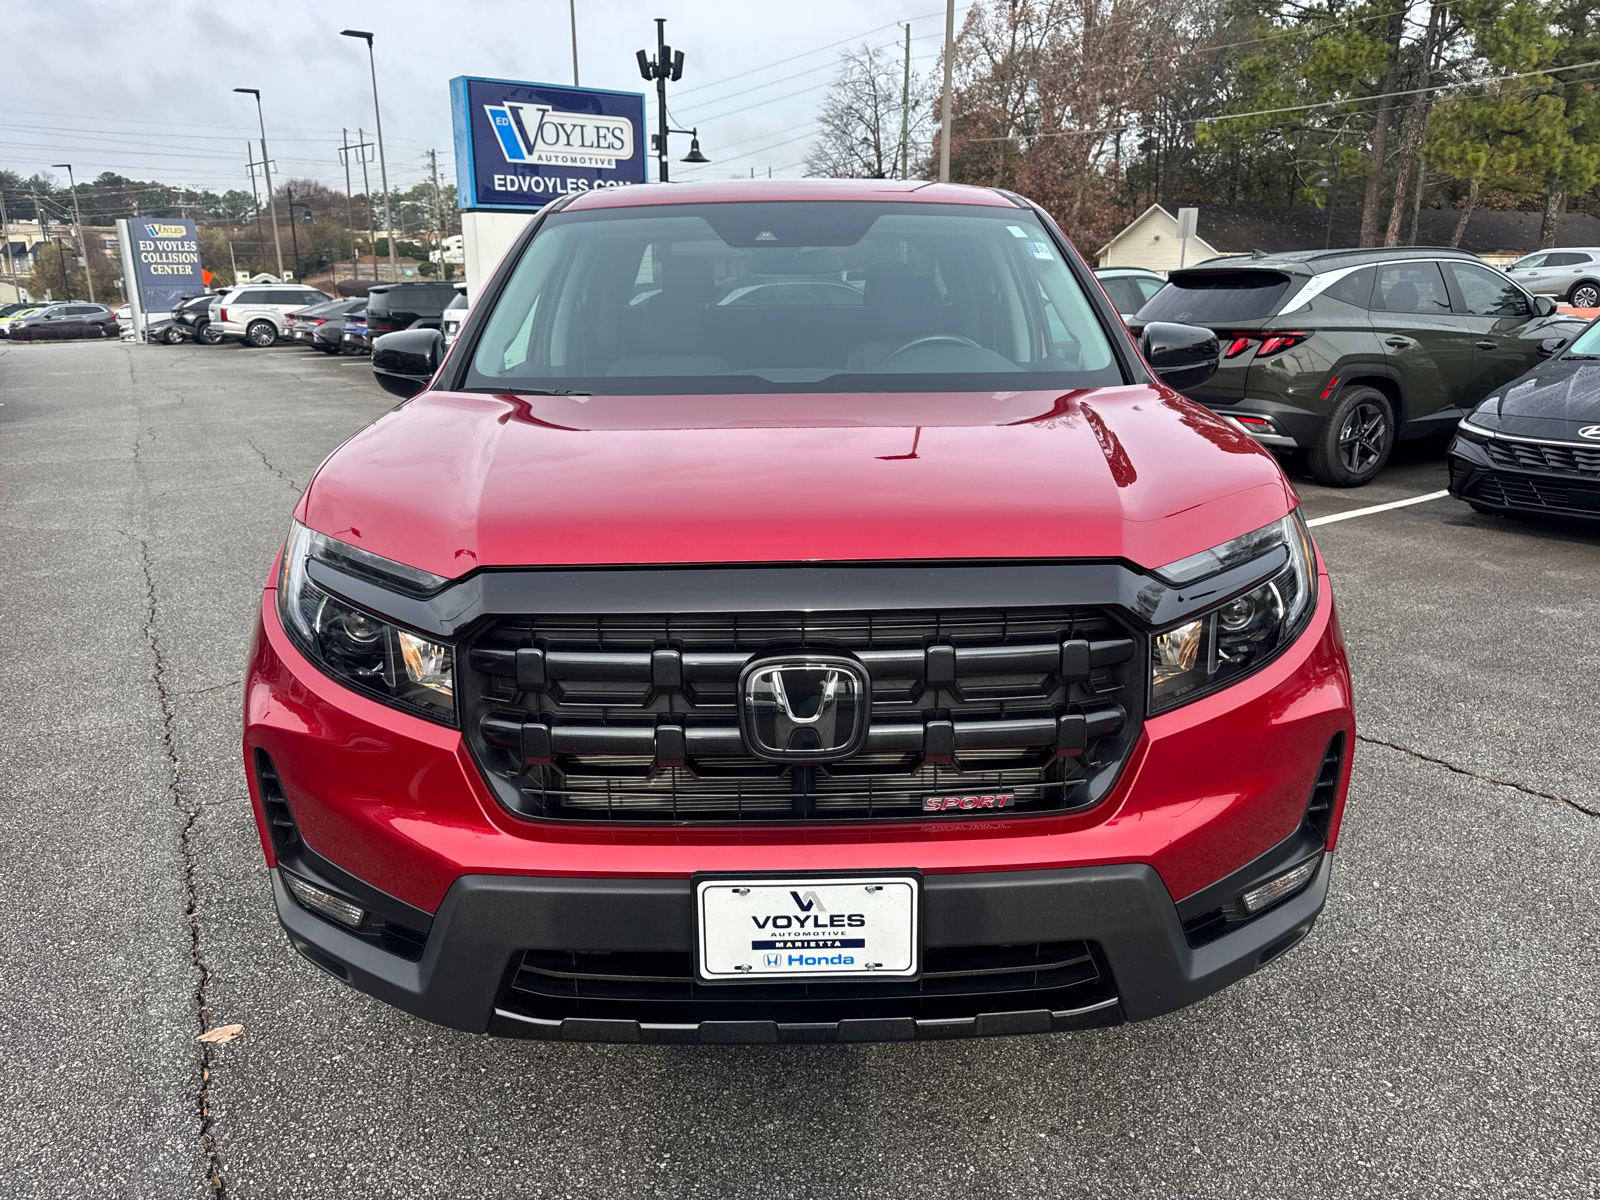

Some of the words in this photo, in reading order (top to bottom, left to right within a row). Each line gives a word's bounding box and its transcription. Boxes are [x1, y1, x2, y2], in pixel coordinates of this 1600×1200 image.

[496, 117, 509, 126] ED
[507, 105, 625, 156] VOYLES
[537, 154, 614, 167] AUTOMOTIVE
[493, 174, 632, 194] EDVOYLESC
[151, 224, 184, 236] VOYLES
[139, 241, 154, 251] ED
[156, 241, 197, 251] VOYLES
[141, 252, 198, 263] COLLISION
[150, 264, 193, 275] CENTER
[923, 793, 1014, 811] SPORT
[751, 913, 866, 929] VOYLES
[775, 940, 842, 949] MARIETTA
[787, 953, 855, 966] Honda
